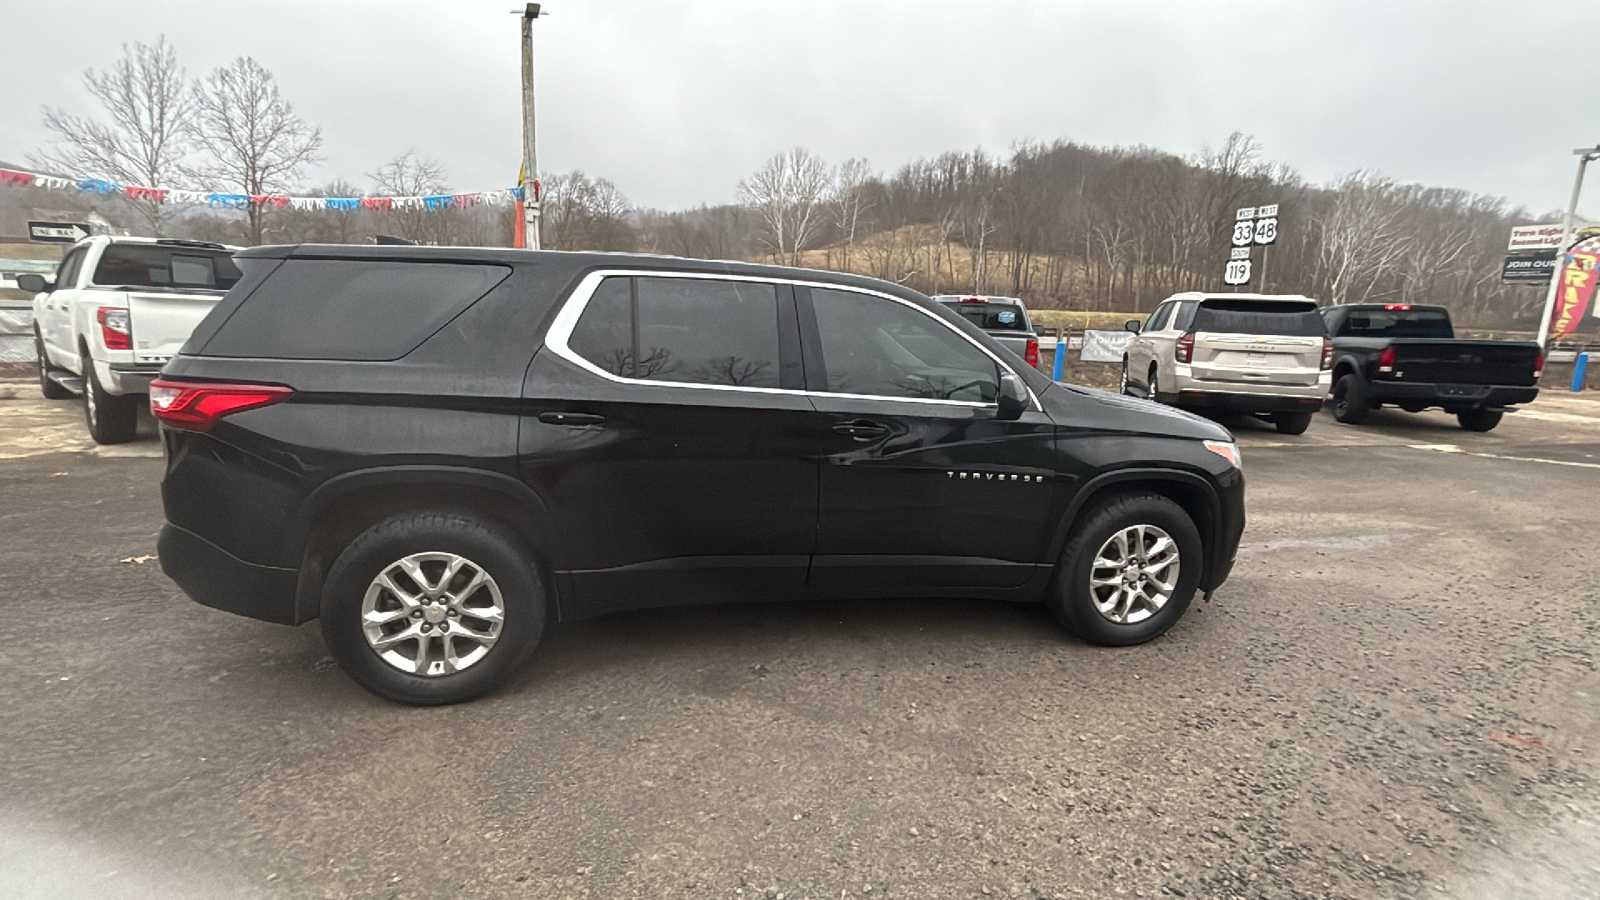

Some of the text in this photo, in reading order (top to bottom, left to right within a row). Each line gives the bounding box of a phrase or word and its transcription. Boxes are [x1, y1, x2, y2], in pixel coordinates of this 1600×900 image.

[1239, 209, 1253, 217] WEST
[1261, 206, 1276, 215] WEST
[1235, 225, 1252, 240] 33
[1257, 223, 1274, 239] 48
[1533, 260, 1556, 268] OUR
[1230, 265, 1246, 279] 119
[947, 471, 1043, 483] TRAVERSE
